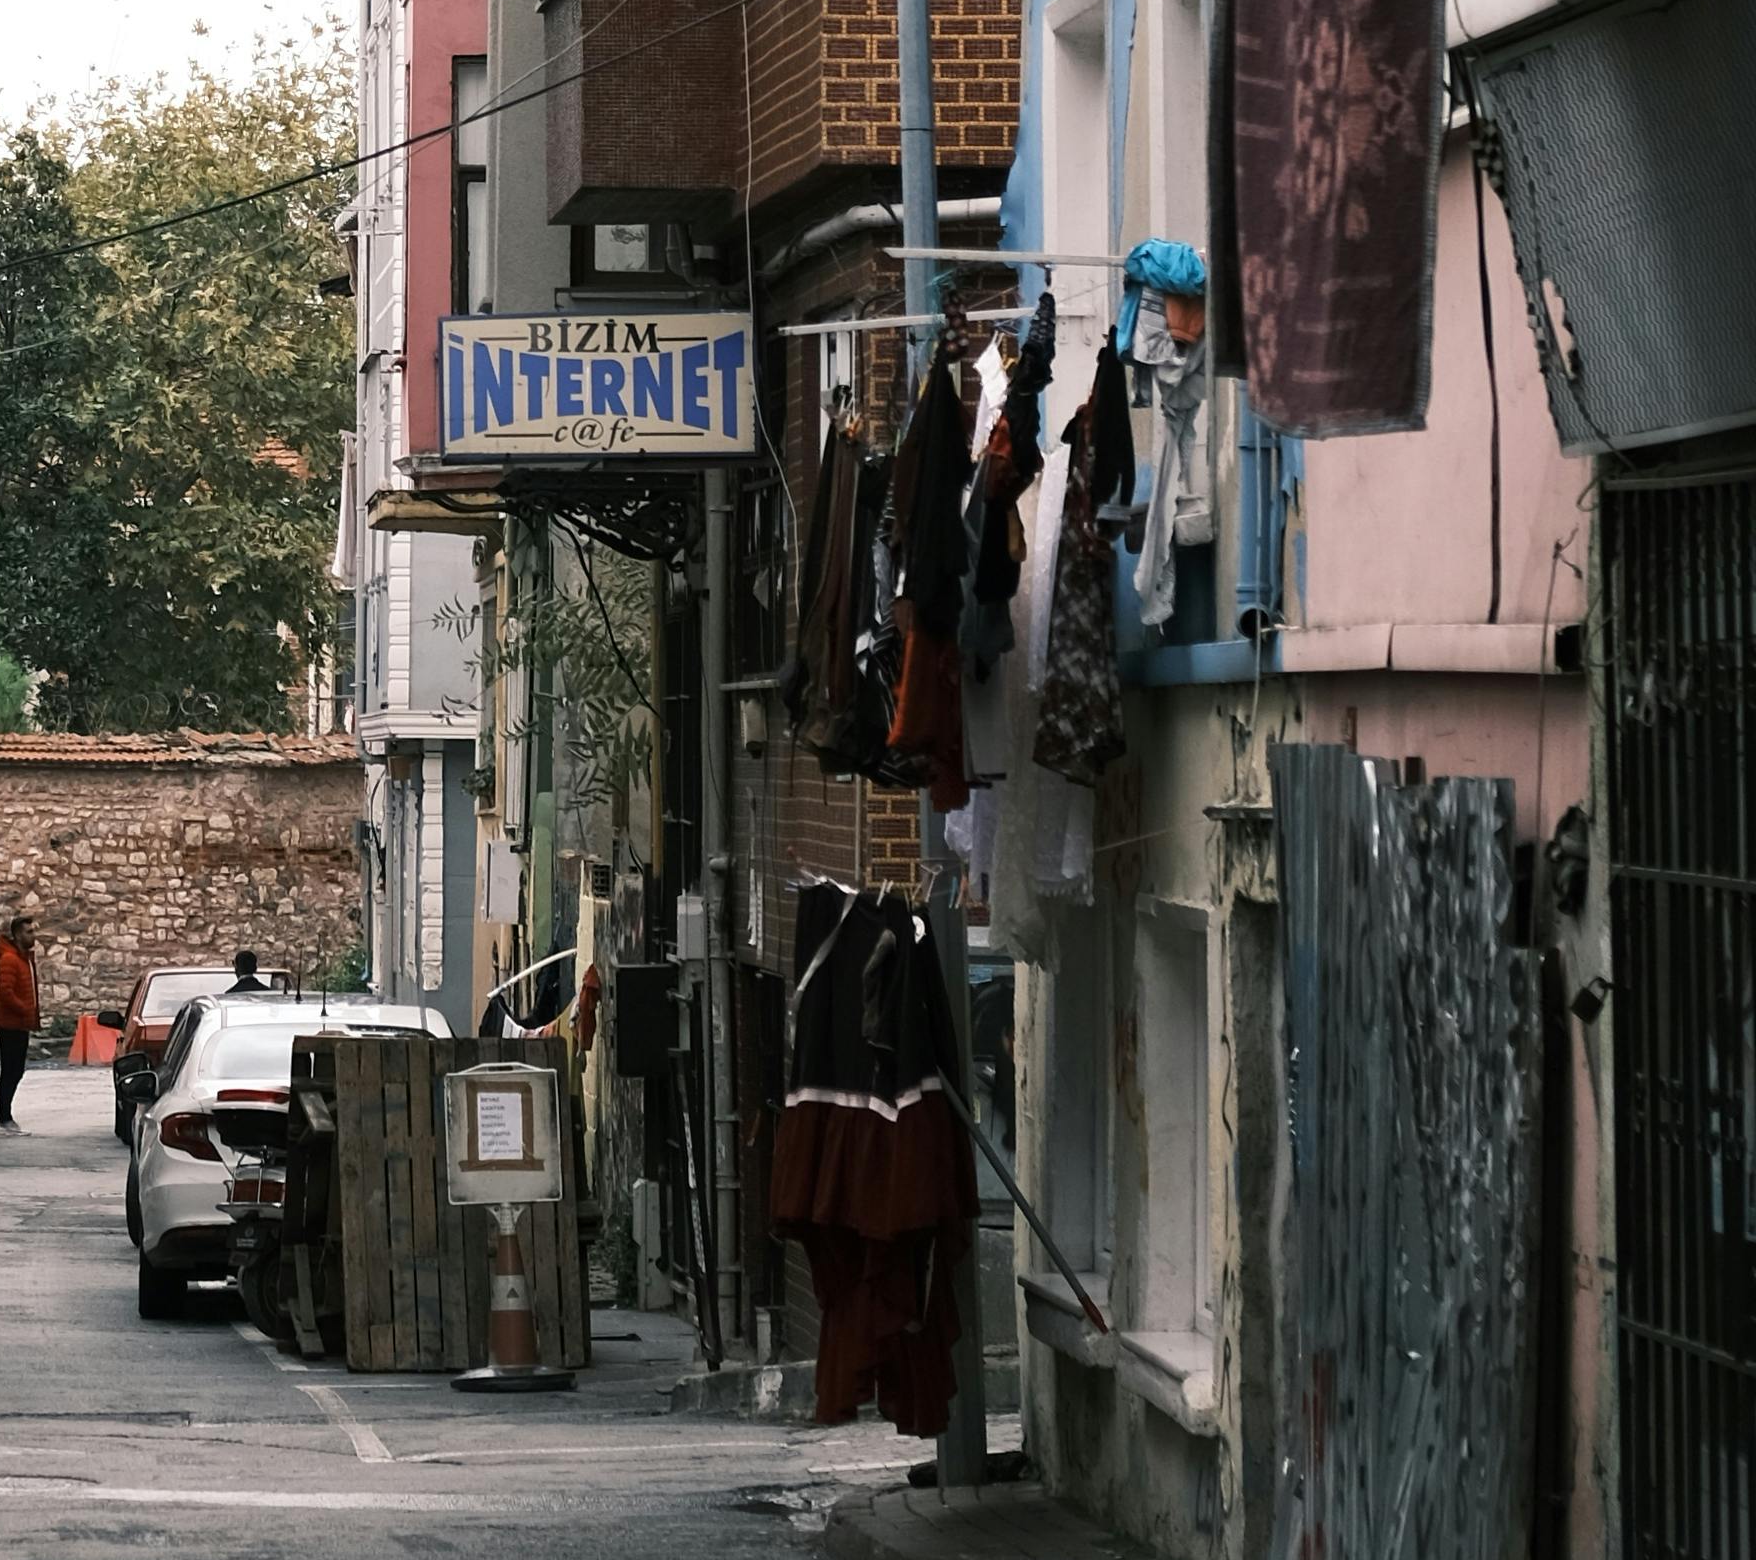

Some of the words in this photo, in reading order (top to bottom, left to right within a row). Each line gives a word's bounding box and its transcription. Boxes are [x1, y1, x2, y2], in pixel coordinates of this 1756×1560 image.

[527, 318, 660, 352] BİZİM
[448, 331, 744, 442] İNTERNET
[554, 417, 635, 451] c@fe
